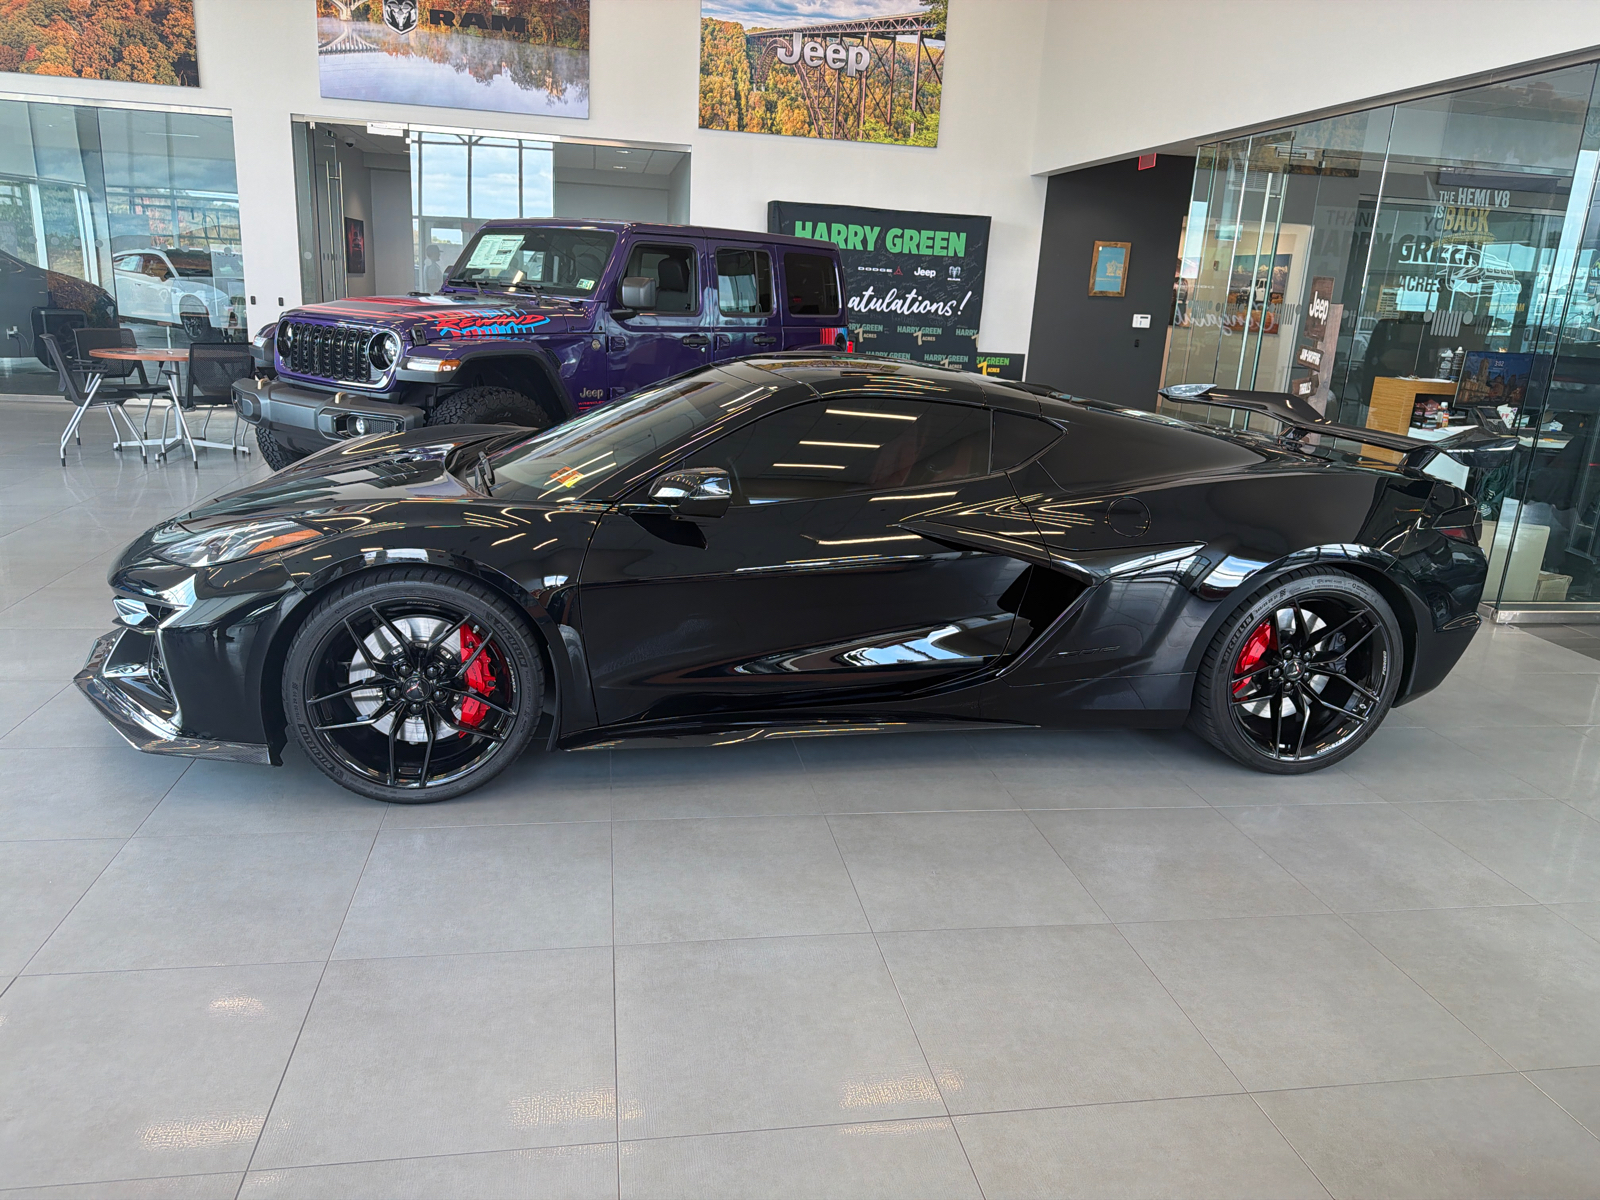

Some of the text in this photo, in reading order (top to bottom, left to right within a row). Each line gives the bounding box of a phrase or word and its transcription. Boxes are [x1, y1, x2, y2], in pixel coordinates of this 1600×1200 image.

[429, 9, 525, 33] RAM
[777, 31, 870, 77] Jeep
[1439, 187, 1511, 208] THE HEMI V8
[1433, 205, 1491, 232] IS BACK
[795, 221, 967, 257] HARRY GREEN
[914, 267, 937, 279] Jeep
[848, 285, 973, 316] atulations!
[1308, 290, 1330, 325] Jeep
[436, 313, 546, 330] REWIND
[861, 324, 884, 332] GREEN
[897, 325, 942, 335] HARRY GREEN
[956, 328, 979, 337] HARRY
[924, 353, 969, 363] HARRY GREEN
[985, 357, 1010, 366] GREEN
[579, 387, 603, 399] Jeep
[497, 622, 527, 667] MICHELIN
[1223, 614, 1252, 662] MICHELIN
[299, 726, 332, 769] MICHELIN
